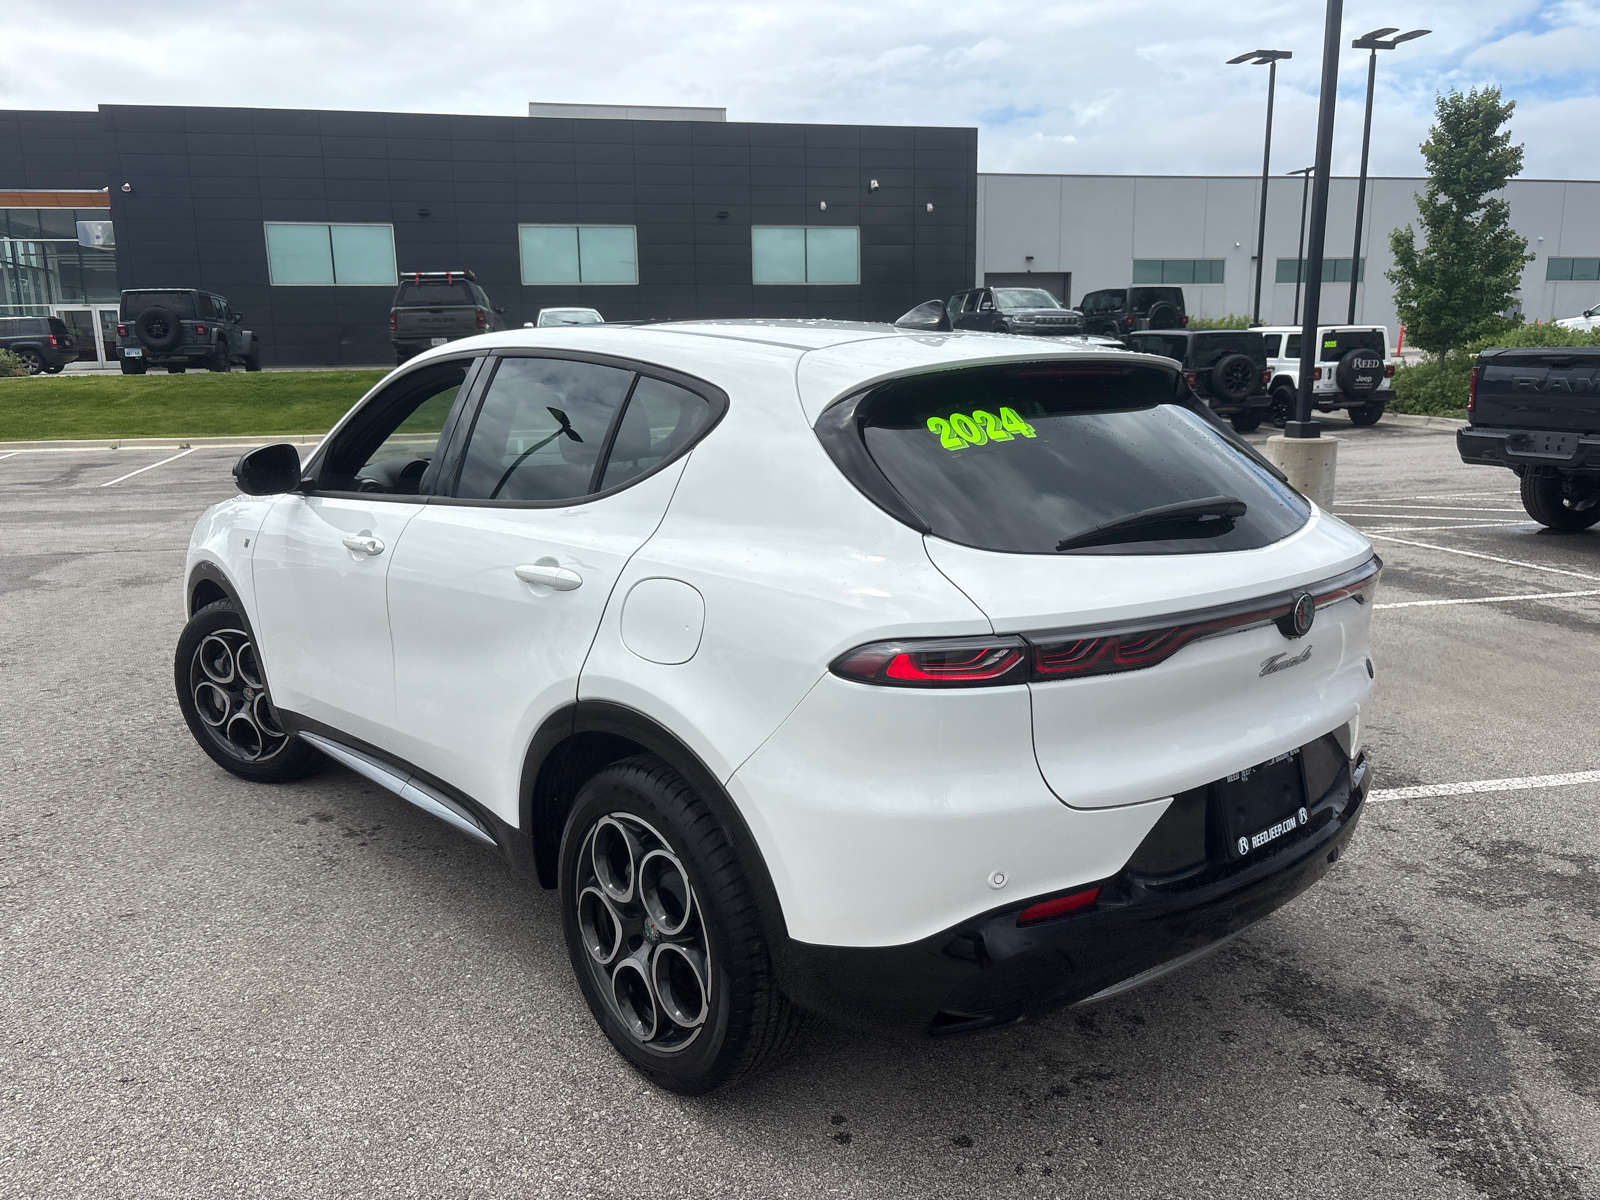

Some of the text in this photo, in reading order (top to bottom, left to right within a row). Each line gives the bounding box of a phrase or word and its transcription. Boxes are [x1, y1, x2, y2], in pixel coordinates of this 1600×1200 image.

[1352, 358, 1380, 370] REED
[1355, 375, 1373, 383] Jeep
[1511, 376, 1600, 394] RAM
[926, 406, 1037, 452] 2024
[1251, 817, 1297, 849] REEDJEEP.COM
